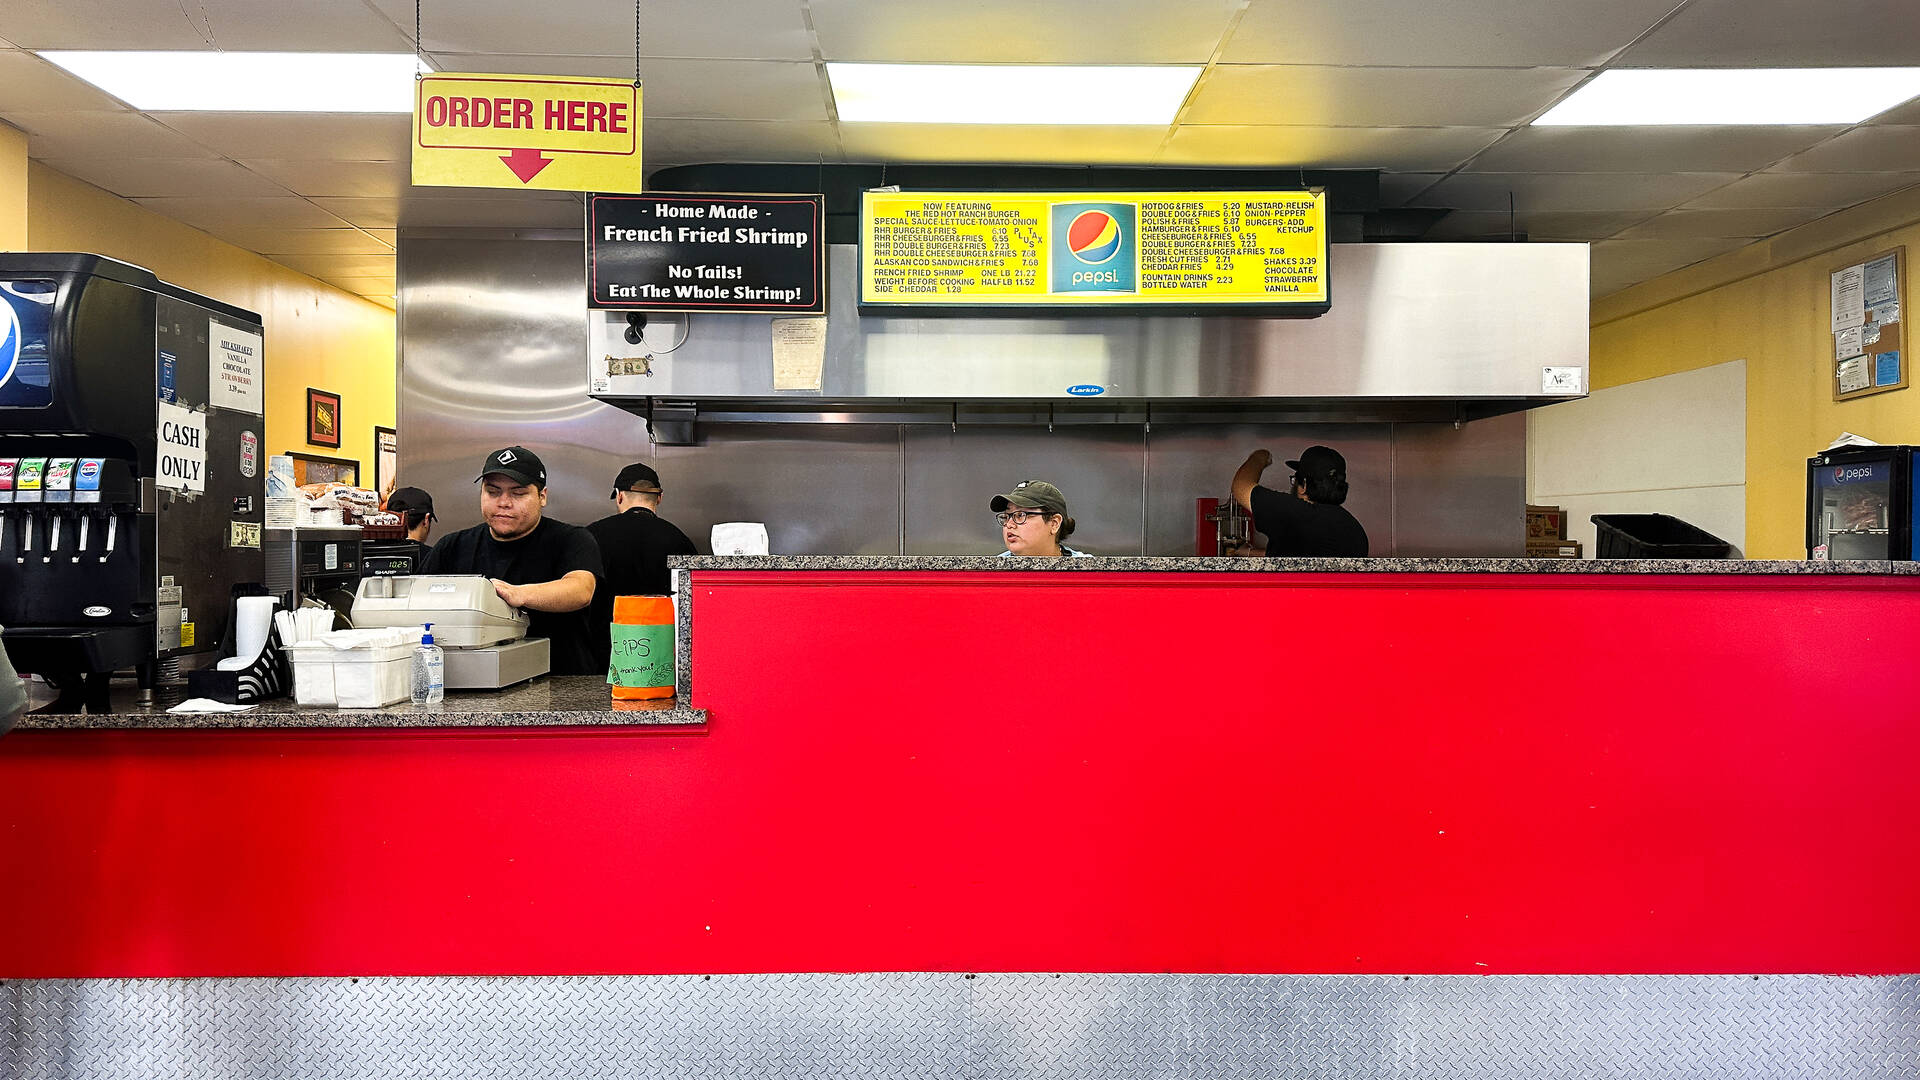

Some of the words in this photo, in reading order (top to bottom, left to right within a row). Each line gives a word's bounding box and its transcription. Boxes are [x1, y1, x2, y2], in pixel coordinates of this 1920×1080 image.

[426, 96, 534, 129] ORDER
[545, 100, 627, 133] HERE
[655, 204, 704, 218] Home
[708, 205, 758, 219] Made
[604, 225, 673, 242] French
[678, 227, 730, 243] Fried
[735, 228, 808, 248] Shrimp
[668, 265, 692, 278] No
[695, 265, 742, 280] Tails!
[609, 284, 637, 298] Eat
[640, 284, 670, 298] The
[674, 285, 730, 299] Whole
[734, 286, 801, 303] Shrimp!
[227, 352, 247, 365] VANILLA
[222, 362, 251, 376] CHOCOLATE
[163, 421, 200, 449] CASH
[162, 455, 200, 481] ONLY
[1846, 466, 1872, 480] pepsi
